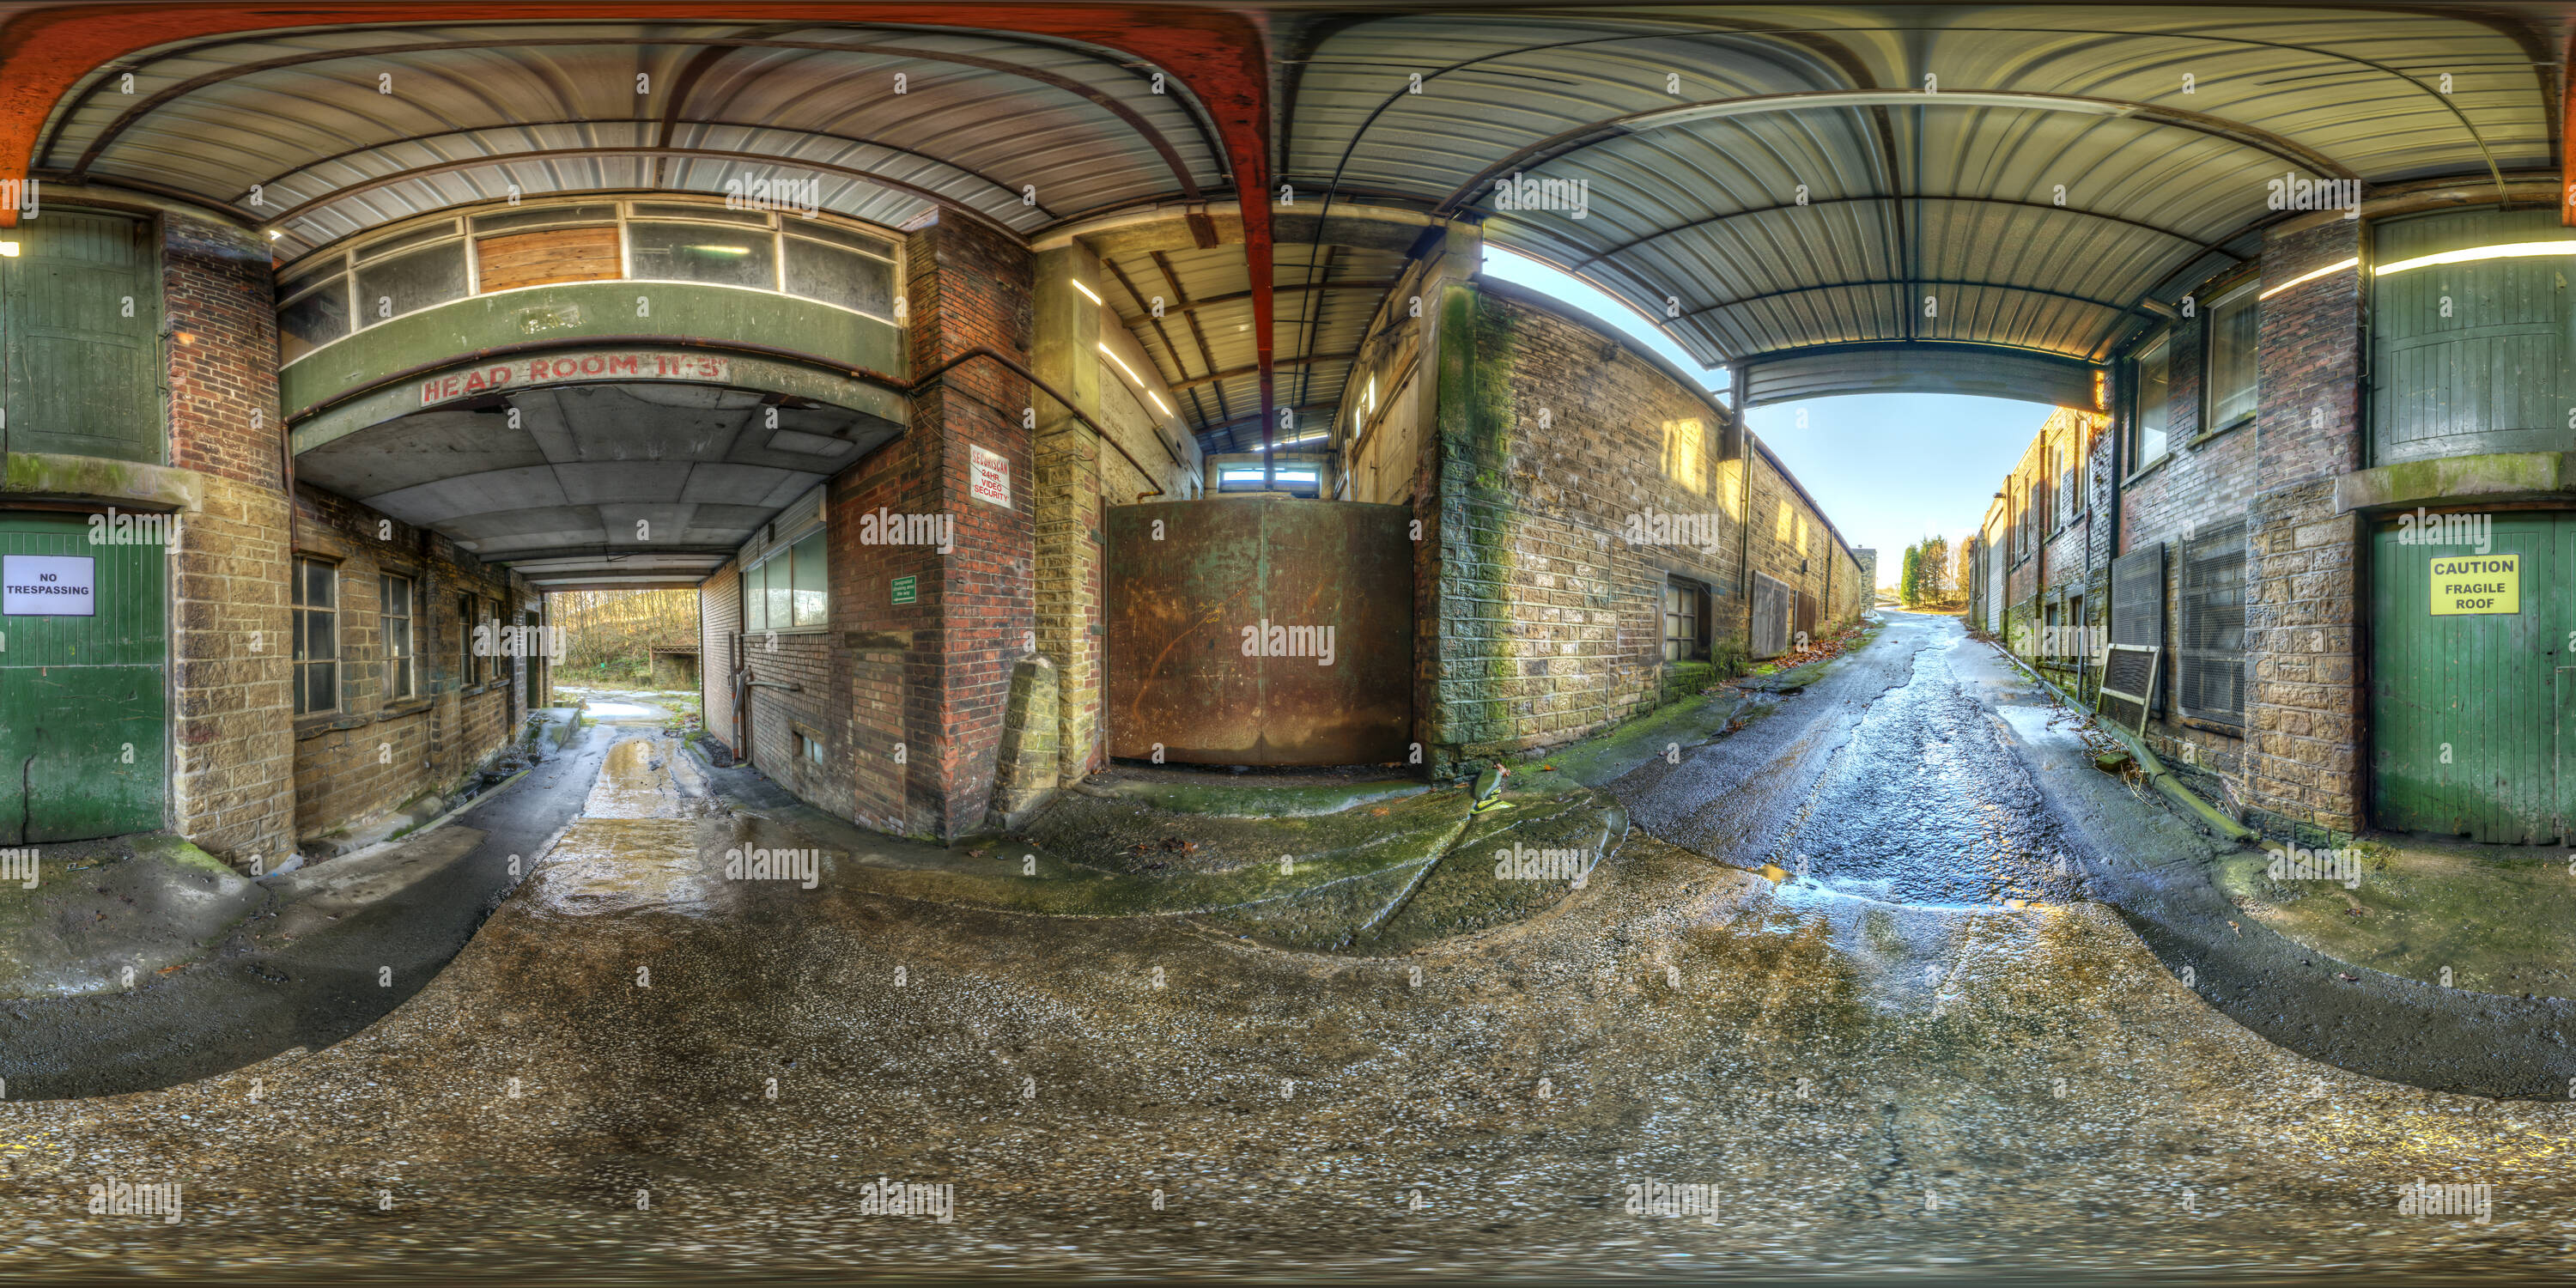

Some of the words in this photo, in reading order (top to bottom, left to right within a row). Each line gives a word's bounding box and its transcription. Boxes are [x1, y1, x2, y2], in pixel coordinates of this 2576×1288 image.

[424, 367, 512, 402] HEAD
[530, 355, 638, 381] ROOM
[981, 478, 1002, 492] VIDEO
[974, 484, 1008, 501] SECURITY
[2434, 561, 2514, 575] CAUTION
[39, 574, 57, 582] NO
[7, 586, 89, 595] TRESPASSING
[2445, 583, 2506, 594] FRAGILE
[2456, 598, 2494, 609] ROOF
